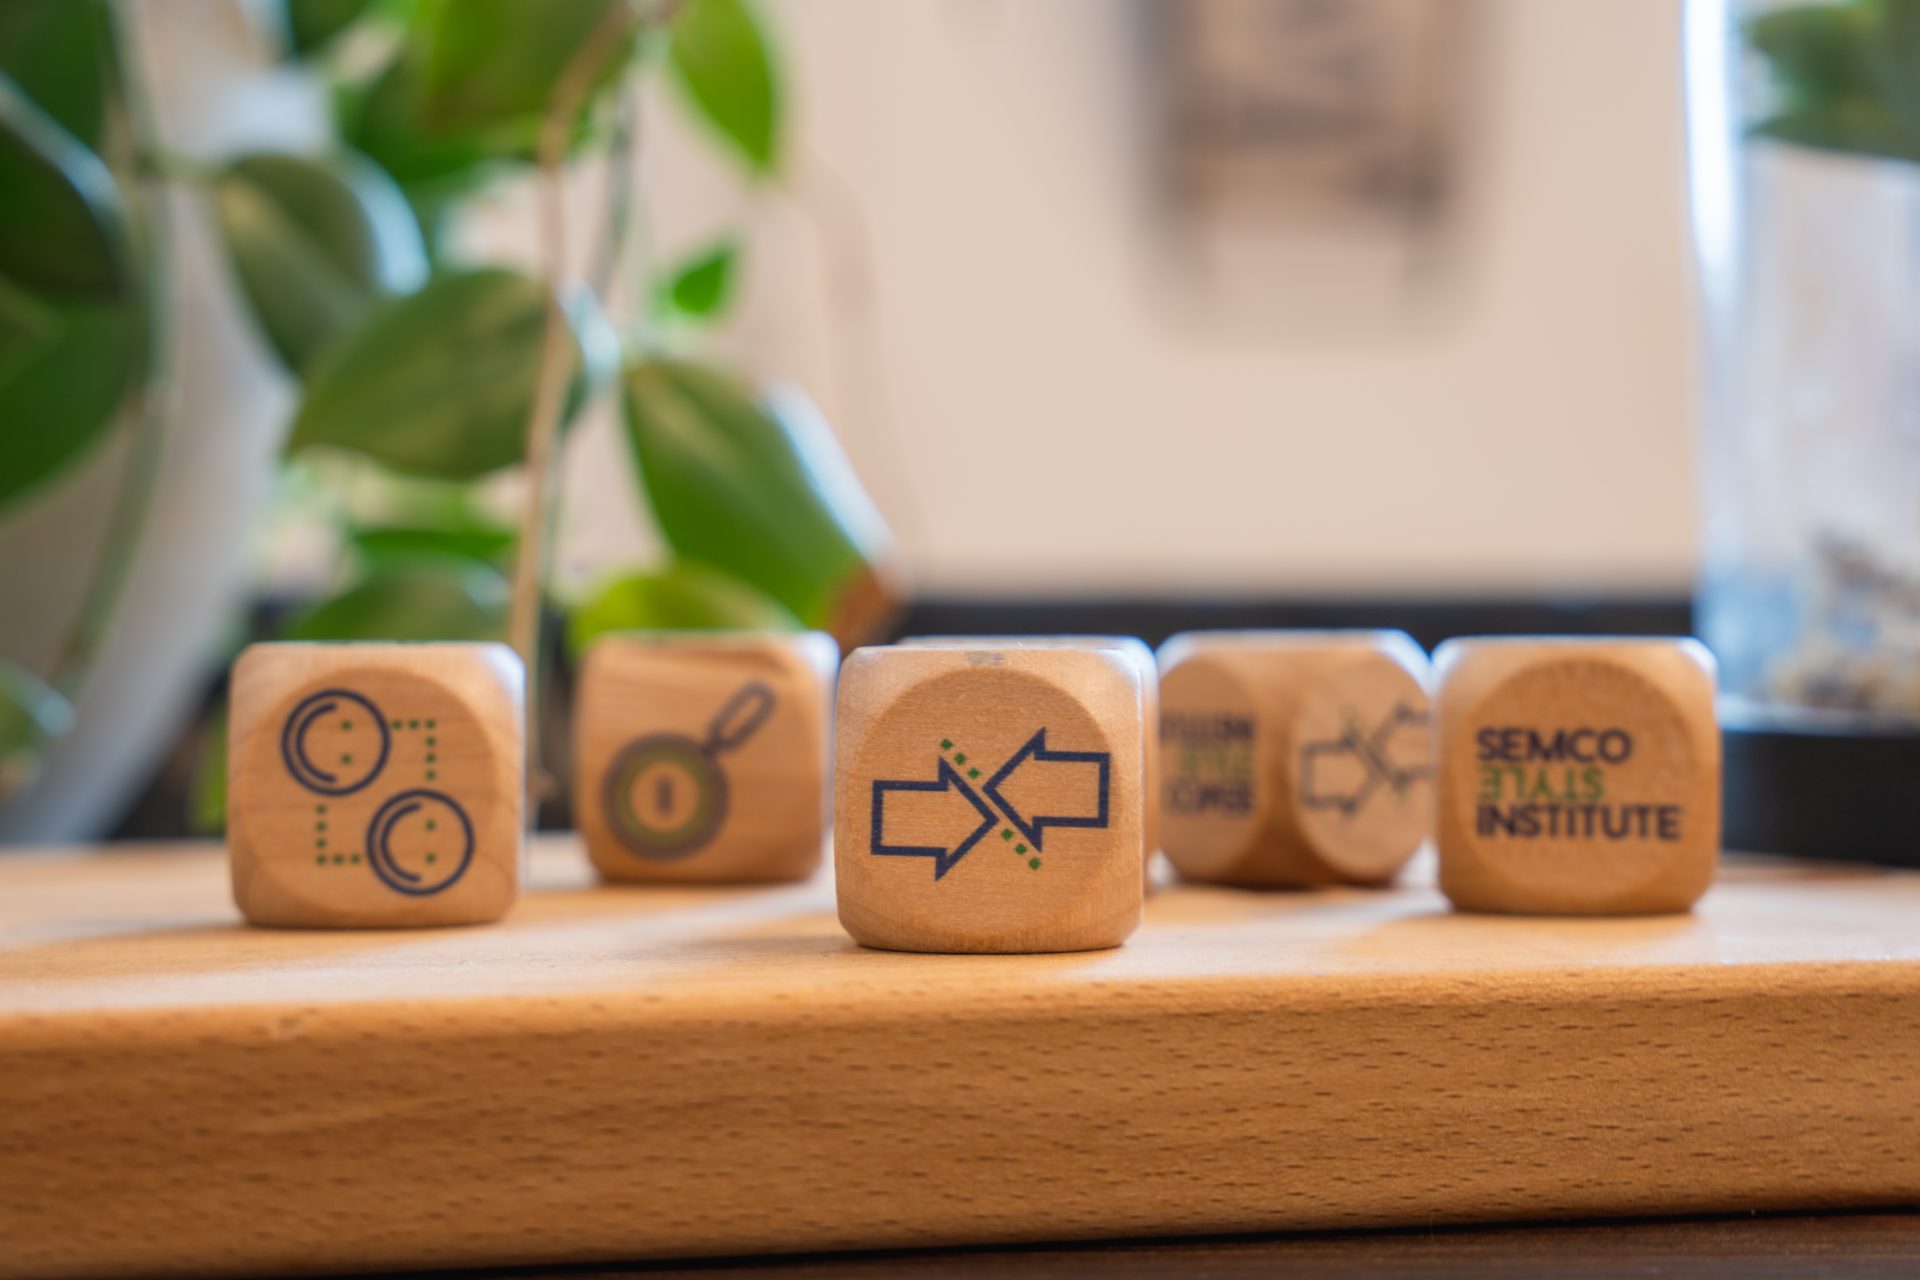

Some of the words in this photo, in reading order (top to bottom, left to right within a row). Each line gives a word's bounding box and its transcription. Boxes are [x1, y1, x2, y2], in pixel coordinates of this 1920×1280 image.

[1477, 728, 1633, 764] SEMCO
[1478, 766, 1604, 801] STYLE
[1477, 805, 1683, 841] INSTITUTE
